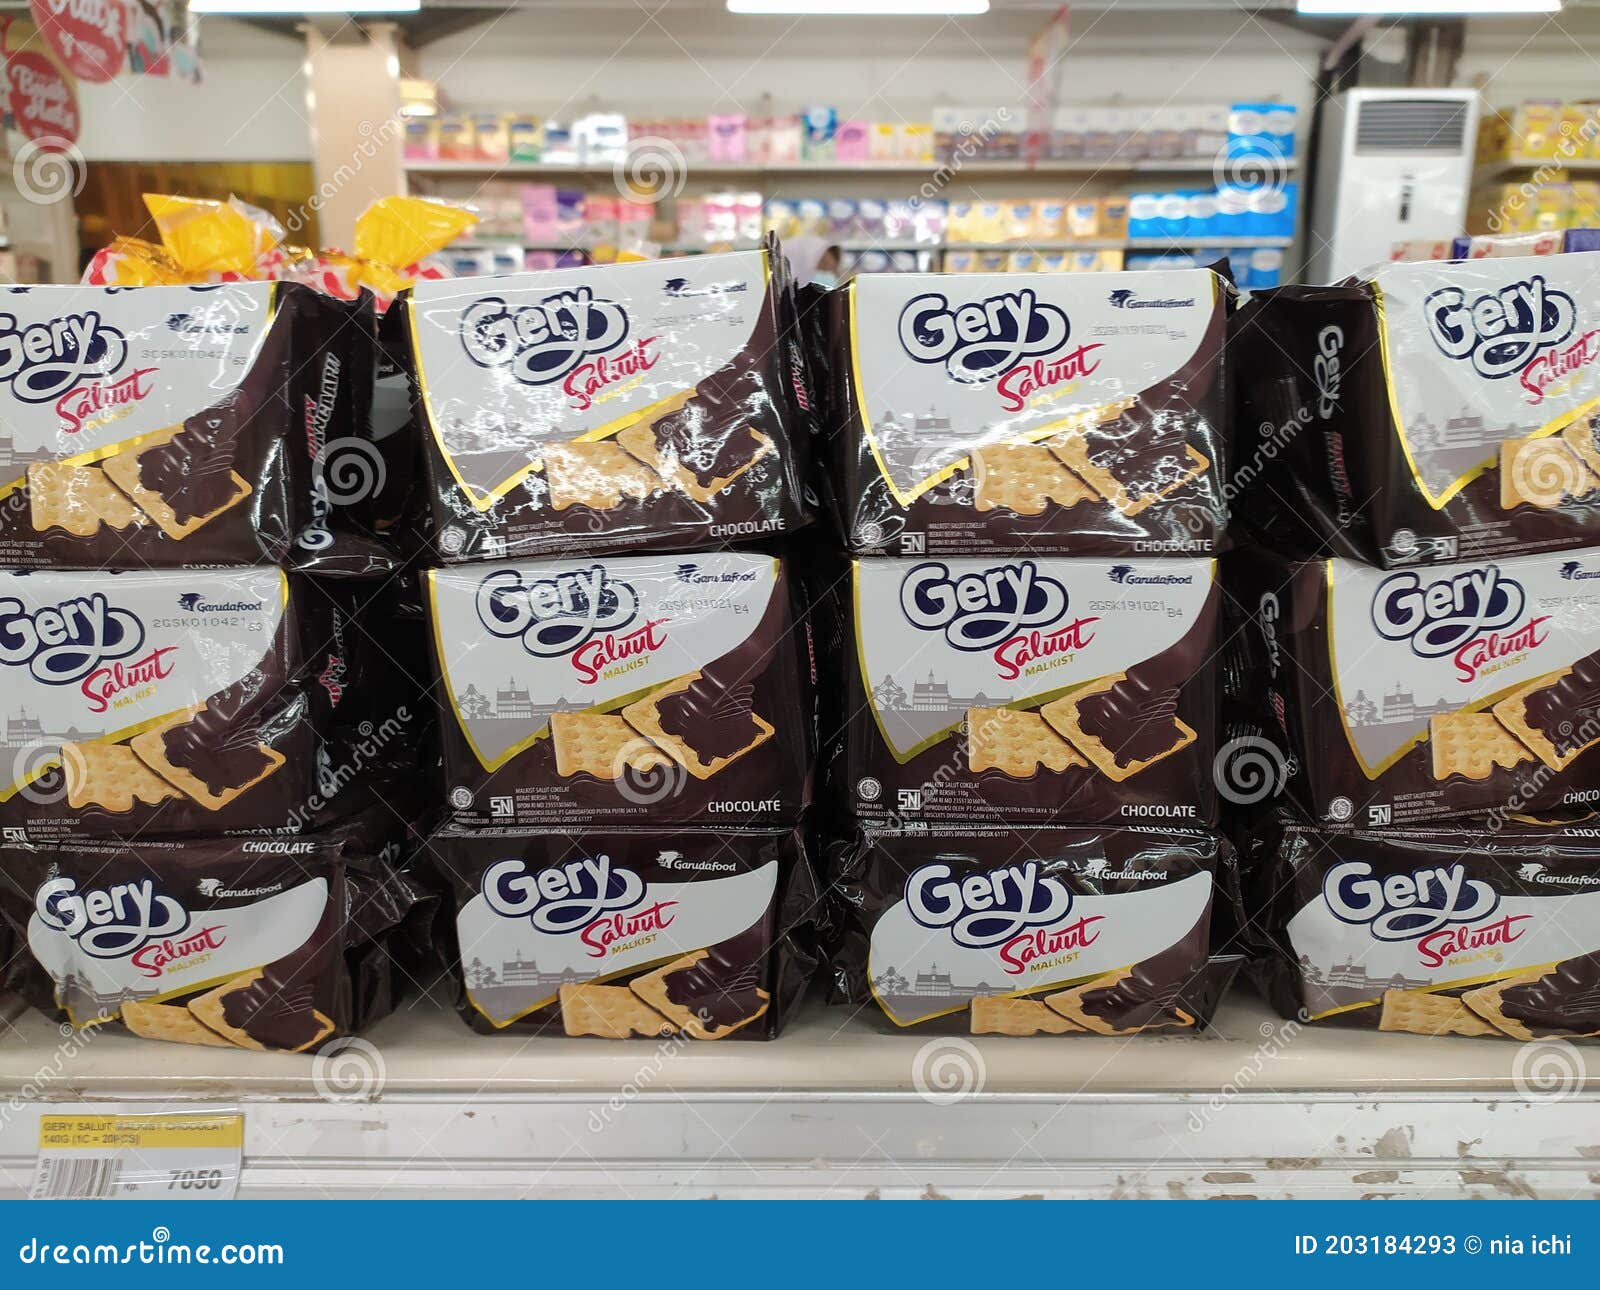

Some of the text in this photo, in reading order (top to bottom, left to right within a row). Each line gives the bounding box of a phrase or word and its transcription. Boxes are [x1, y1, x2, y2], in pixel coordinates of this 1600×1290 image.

[460, 286, 630, 386] Gery
[898, 289, 1071, 384] Gery
[1423, 275, 1577, 380] Gery
[1313, 325, 1345, 420] Gery
[709, 518, 786, 538] CHOCOLATE
[900, 532, 926, 554] SNI
[1134, 538, 1213, 553] CHOCOLATE
[1126, 575, 1193, 585] Garudafood
[197, 601, 262, 612] Garudafood
[476, 564, 639, 658] Gery
[899, 560, 1070, 652] Gery
[1089, 600, 1184, 617] 2GSK191021 B4
[1371, 564, 1527, 659] Gery
[603, 654, 651, 681] MALKIST
[1024, 653, 1076, 678] MALKIST
[1480, 652, 1530, 678] MALKIST
[489, 796, 514, 816] SNI
[708, 800, 781, 813] CHOCOLATE
[898, 788, 921, 810] SNI
[1121, 804, 1196, 818] CHOCOLATE
[1368, 804, 1391, 827] SNI
[242, 841, 316, 854] CHOCOLATE
[674, 858, 737, 872] Garudafood
[1102, 869, 1168, 882] Garudafood
[215, 883, 283, 898] Garudafood
[482, 853, 648, 936] Gery
[905, 860, 1074, 950] Gery
[1322, 861, 1501, 943] Gery
[35, 877, 191, 960] Gery
[612, 933, 659, 955] MALKIST
[167, 953, 212, 975] MALKIST
[1030, 952, 1081, 973] MALKIST
[44, 1122, 74, 1132] GERY
[77, 1122, 112, 1132] SALUT
[43, 1134, 69, 1144] 140G
[167, 1169, 222, 1190] 7050
